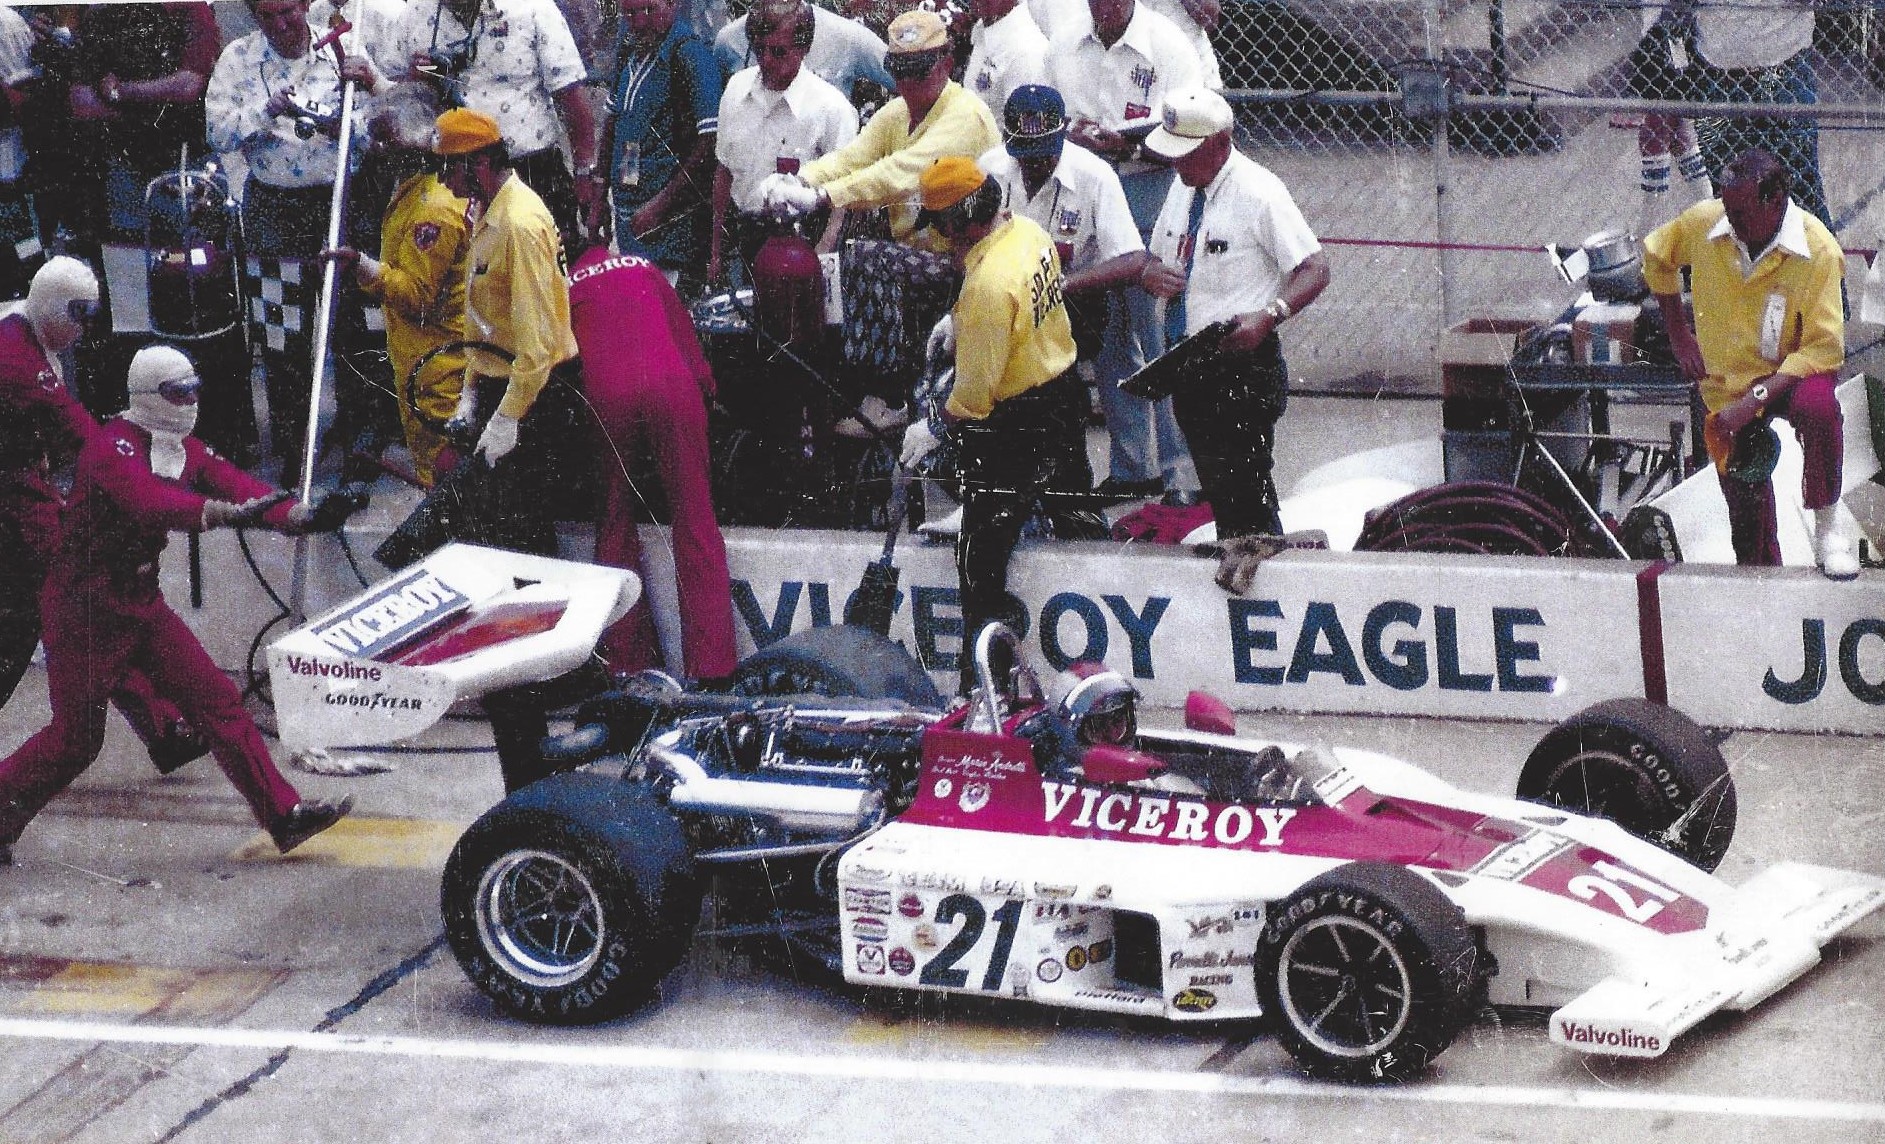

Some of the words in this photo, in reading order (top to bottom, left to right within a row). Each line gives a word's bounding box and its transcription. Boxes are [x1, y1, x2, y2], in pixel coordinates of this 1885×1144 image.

[567, 255, 651, 286] ICEROY
[322, 576, 459, 655] VICEROY
[730, 581, 1172, 681] VIEOY
[1226, 598, 1559, 693] EAGLE
[286, 654, 382, 682] Valvoline
[324, 691, 423, 711] GOODYEAR
[1041, 781, 1297, 847] VICEROY
[1567, 859, 1682, 924] 21
[918, 893, 1026, 992] 21
[1560, 1020, 1661, 1051] Valvoline
